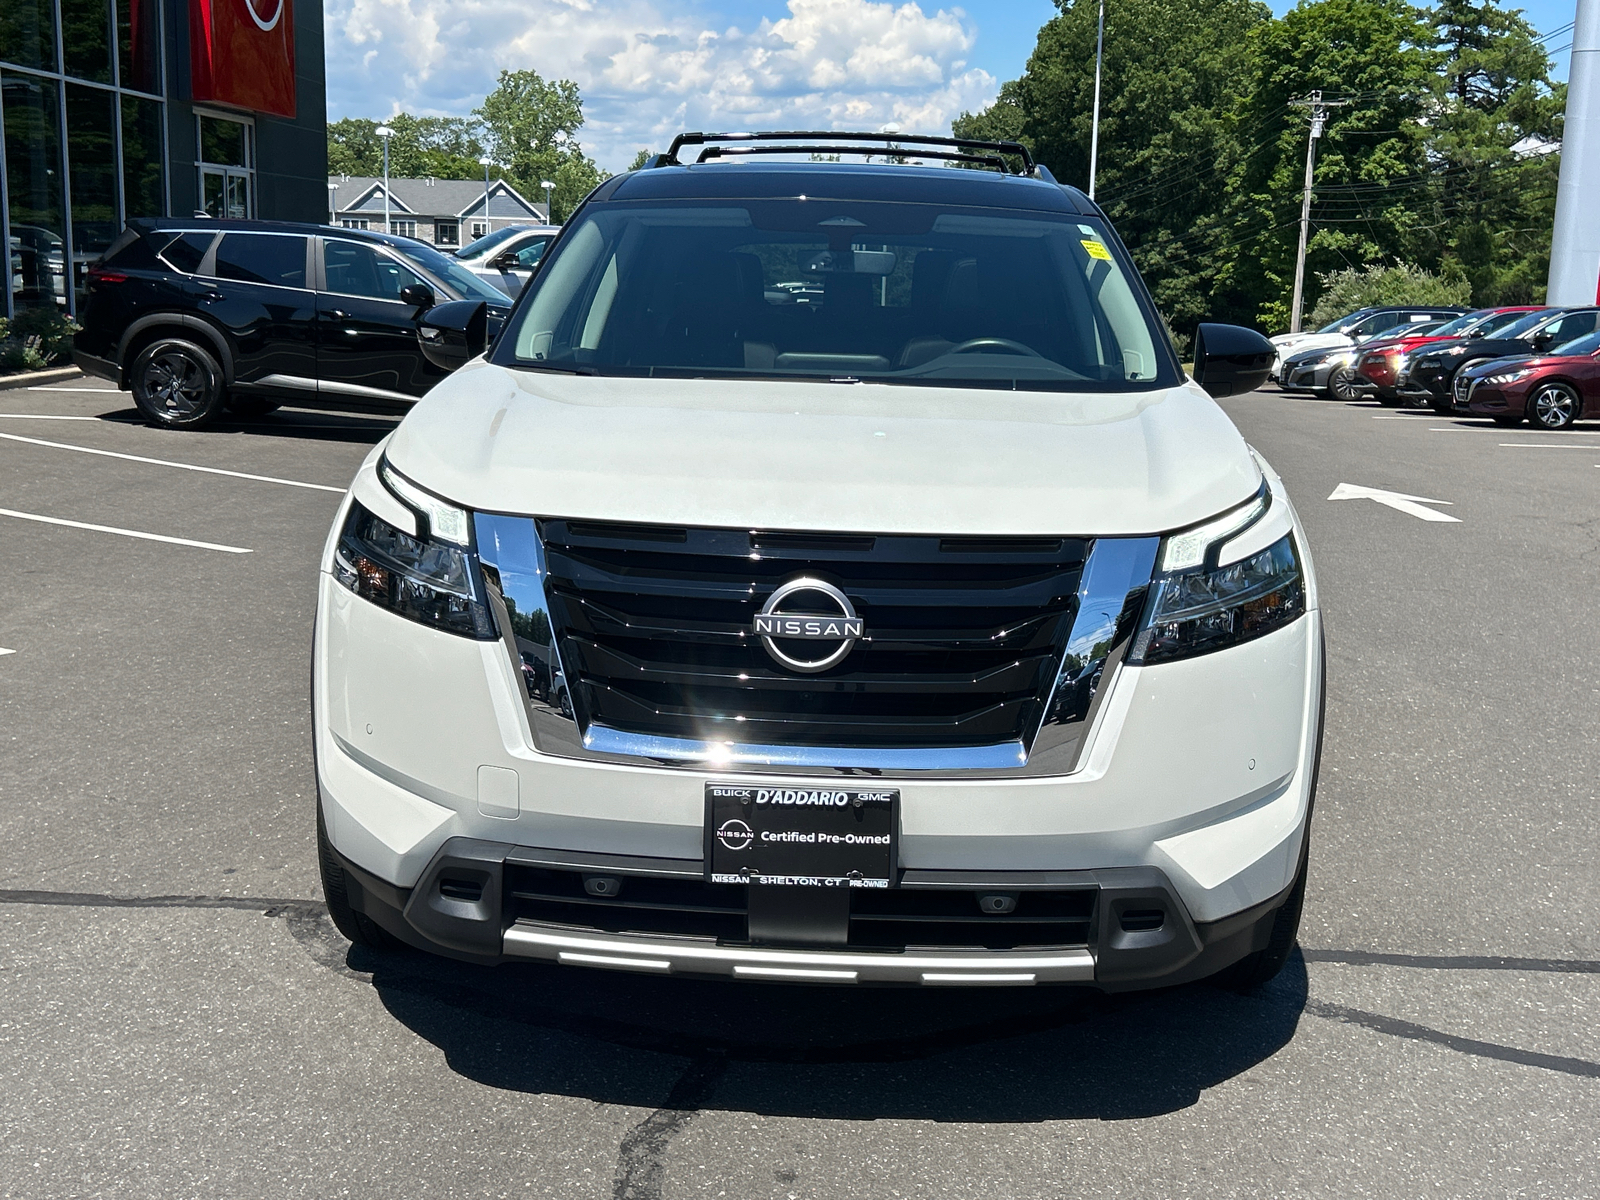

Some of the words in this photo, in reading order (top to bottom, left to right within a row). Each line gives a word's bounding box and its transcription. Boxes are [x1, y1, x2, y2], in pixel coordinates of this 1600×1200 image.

[756, 619, 861, 636] NISSAN
[713, 789, 750, 798] BUICK
[755, 790, 849, 806] D'ADDARIO
[857, 793, 891, 802] GMC
[716, 830, 754, 839] NISSAN
[761, 831, 815, 843] Certified
[818, 834, 890, 844] Pre-Owned
[711, 874, 750, 884] NISSAN
[759, 877, 822, 887] SHELTON,
[824, 878, 842, 886] CT
[849, 880, 888, 888] PRE-OWNED
